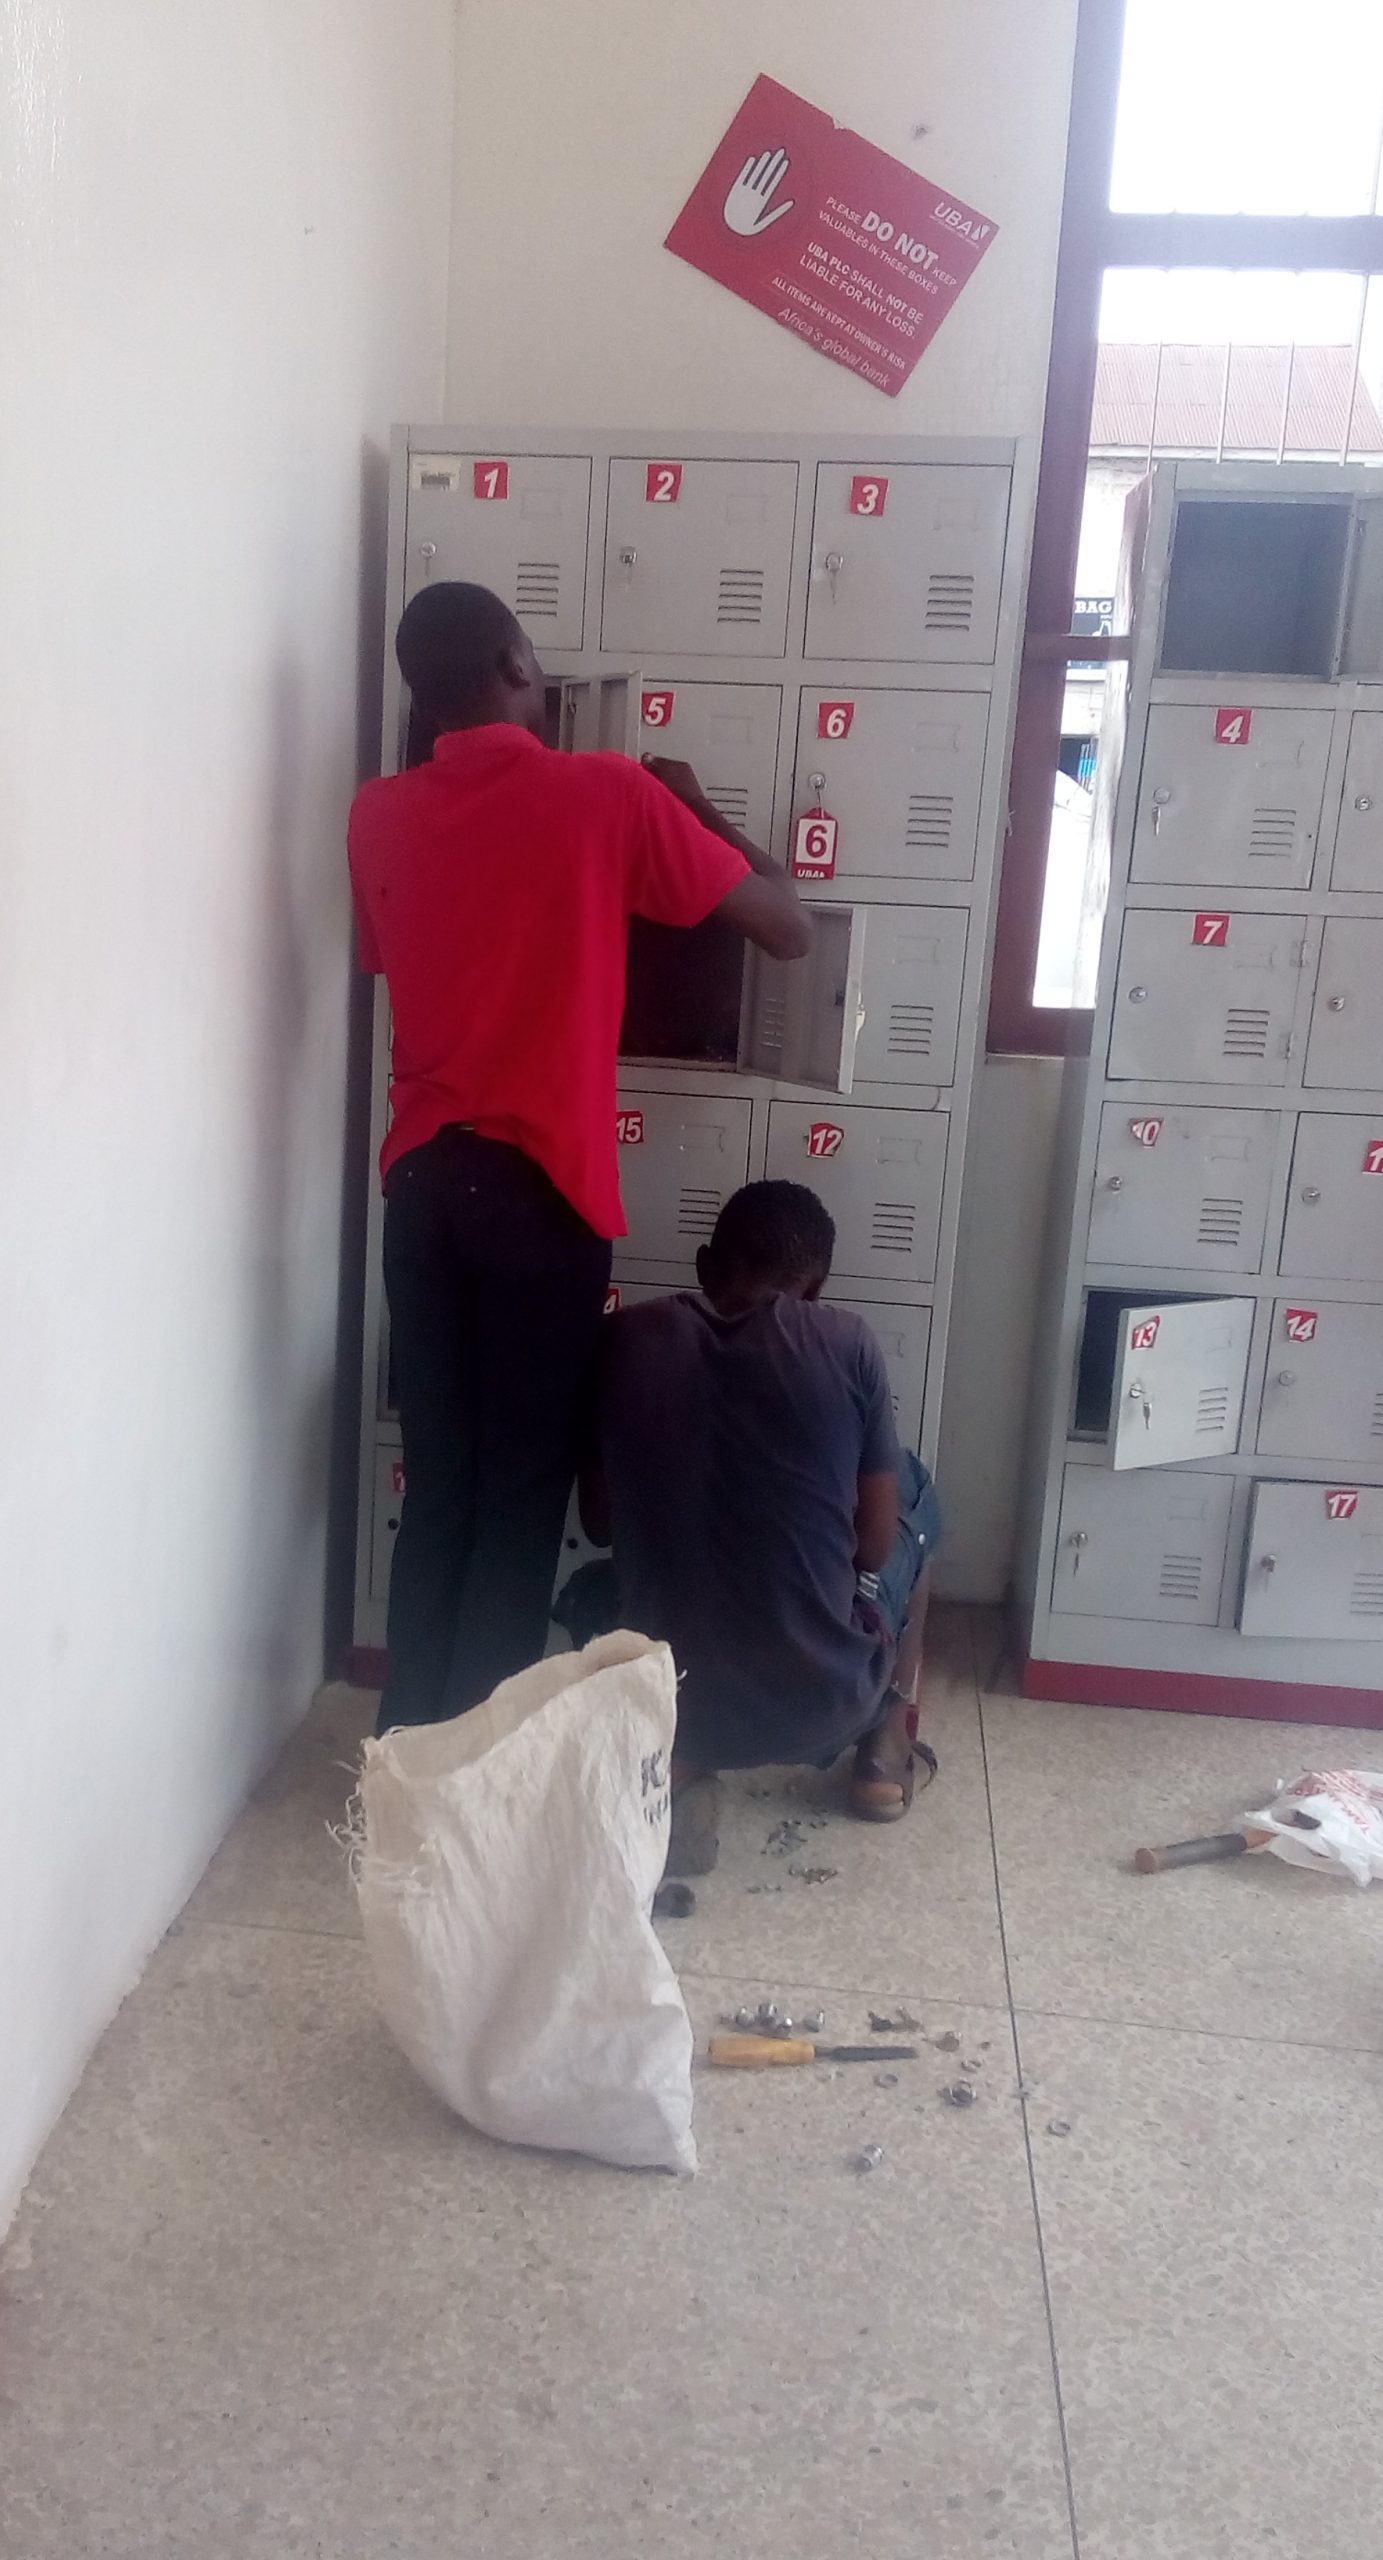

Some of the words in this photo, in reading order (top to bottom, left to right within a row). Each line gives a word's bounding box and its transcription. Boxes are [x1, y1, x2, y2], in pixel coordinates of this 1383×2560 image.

[934, 202, 973, 236] UBA
[819, 210, 868, 248] VALUABLES
[868, 243, 880, 256] IN
[880, 250, 908, 275] THESE
[908, 270, 938, 294] BOXES
[826, 197, 861, 224] PLEASE
[861, 211, 894, 241] DO
[894, 233, 939, 270] NOT
[932, 267, 957, 286] KEEP
[799, 254, 840, 286] LIABLE
[839, 281, 863, 302] FOR
[862, 297, 886, 316] ANY
[885, 312, 915, 339] LOSS.
[807, 241, 828, 262] UBA
[829, 256, 850, 275] PLC
[850, 270, 884, 299] SHALL
[886, 293, 908, 312] NOT
[907, 307, 924, 324] BE
[772, 276, 786, 291] ALL
[786, 284, 811, 306] ITEMS
[810, 300, 825, 316] ARE
[825, 310, 845, 328] KEPT
[844, 323, 855, 335] AT
[854, 330, 888, 358] OWNER'S
[887, 351, 906, 369] RISK
[778, 308, 823, 342] Africa's
[821, 338, 862, 366] global
[860, 360, 890, 387] bank
[484, 467, 499, 498] 1
[653, 471, 675, 501] 2
[857, 484, 880, 514] 3
[645, 697, 666, 725] 5
[826, 708, 847, 738] 6
[1221, 715, 1244, 743] 4
[805, 824, 827, 858] 6
[1202, 920, 1223, 944] 7
[616, 1117, 641, 1142] 15
[813, 1129, 841, 1155] 12
[1132, 1121, 1160, 1145] 10
[1134, 1321, 1157, 1347] 13
[1287, 1315, 1316, 1341] 14
[1328, 1494, 1356, 1517] 17
